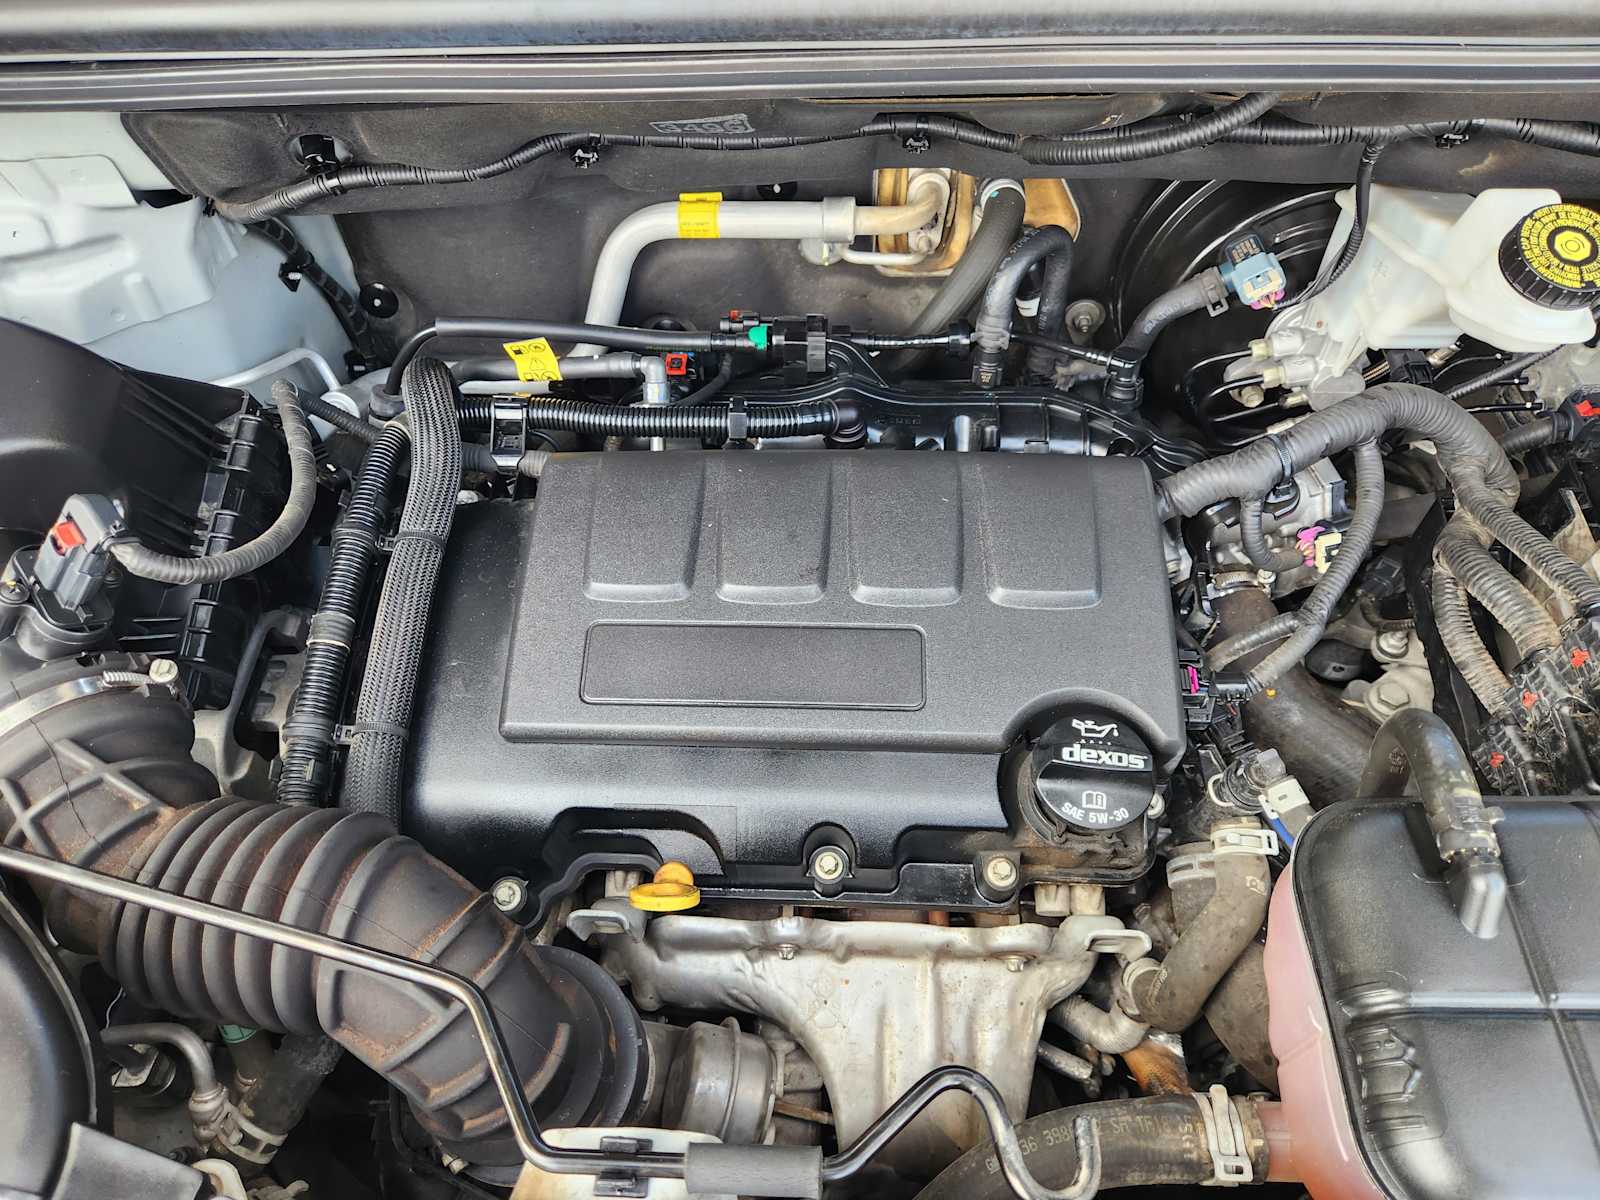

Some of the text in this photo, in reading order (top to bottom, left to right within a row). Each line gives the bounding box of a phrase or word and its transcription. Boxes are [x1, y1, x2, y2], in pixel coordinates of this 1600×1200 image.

[1061, 744, 1145, 769] dexos
[1061, 802, 1130, 825] SAE 5W-30
